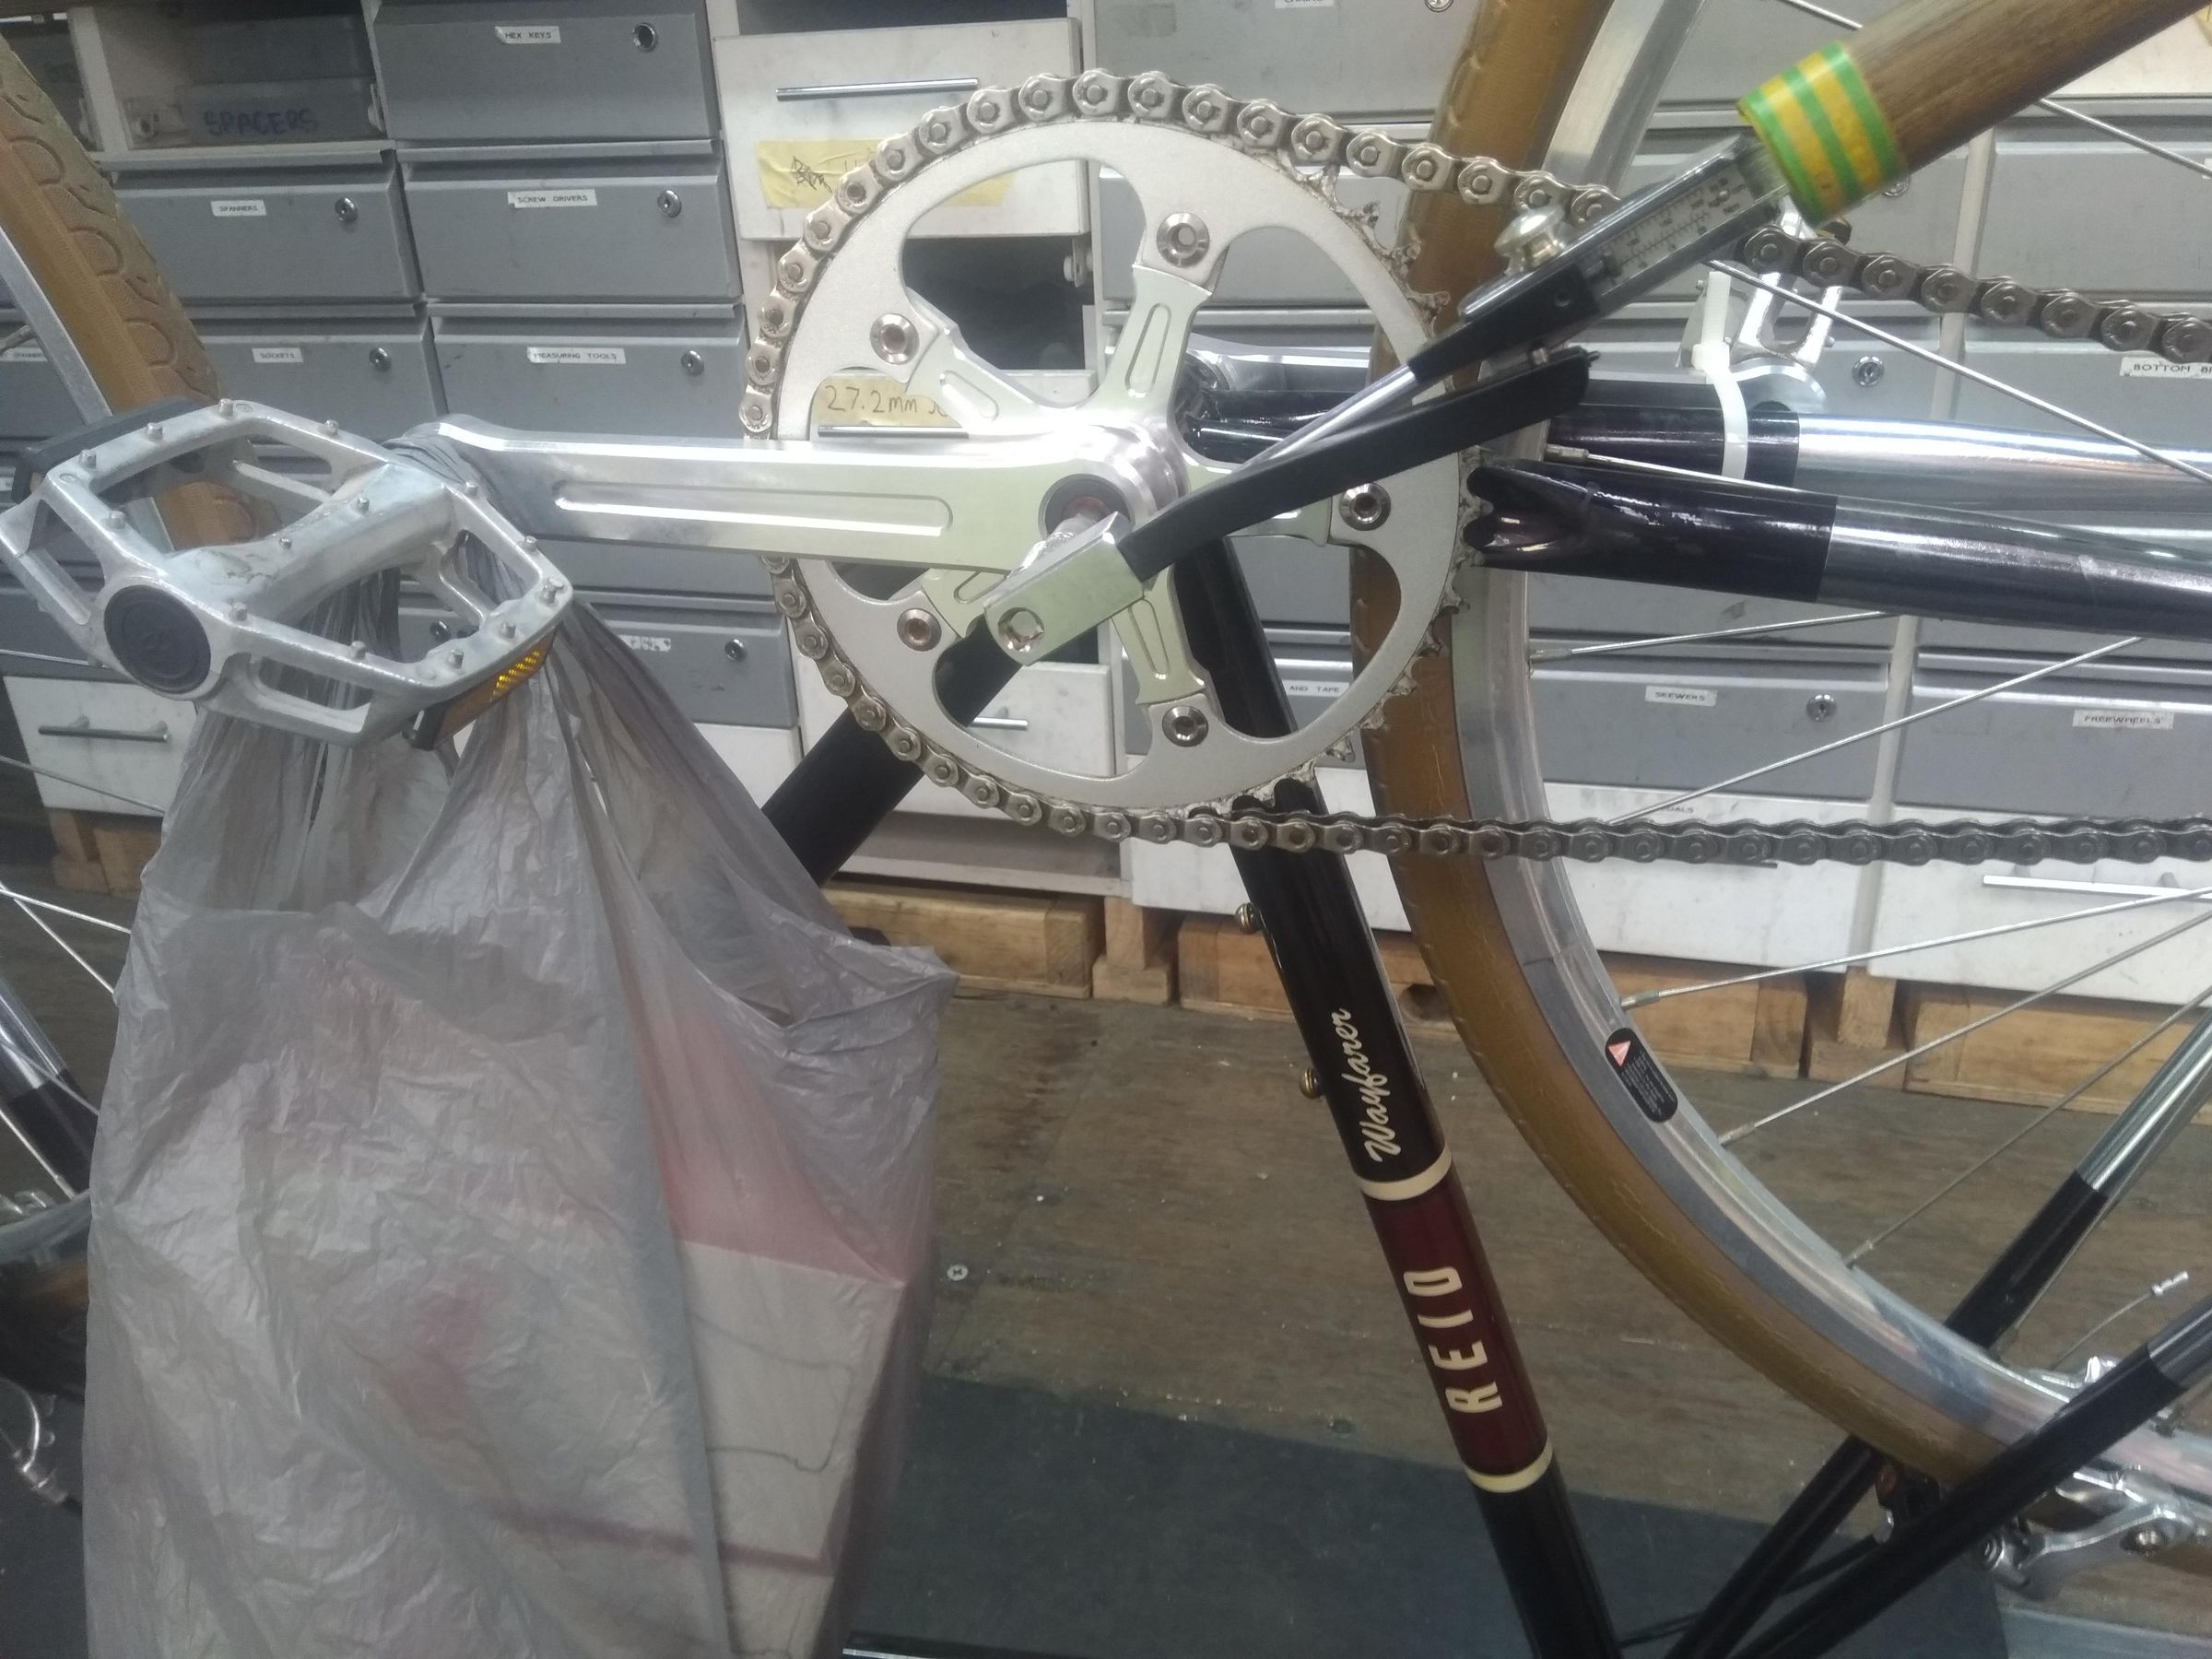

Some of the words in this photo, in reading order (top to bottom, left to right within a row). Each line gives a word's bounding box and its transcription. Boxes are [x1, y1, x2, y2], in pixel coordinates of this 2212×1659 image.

[204, 108, 319, 135] SPACERS
[553, 194, 588, 203] DRIVERS
[588, 352, 618, 360] TOOLS
[2133, 363, 2191, 373] BOTTOM
[825, 384, 918, 414] 27.2mm
[1654, 691, 1705, 701] SKEWERS
[2084, 714, 2161, 724] FREEWHEELS
[1331, 1007, 1402, 1163] Wayfarer
[1403, 1265, 1503, 1414] REID
